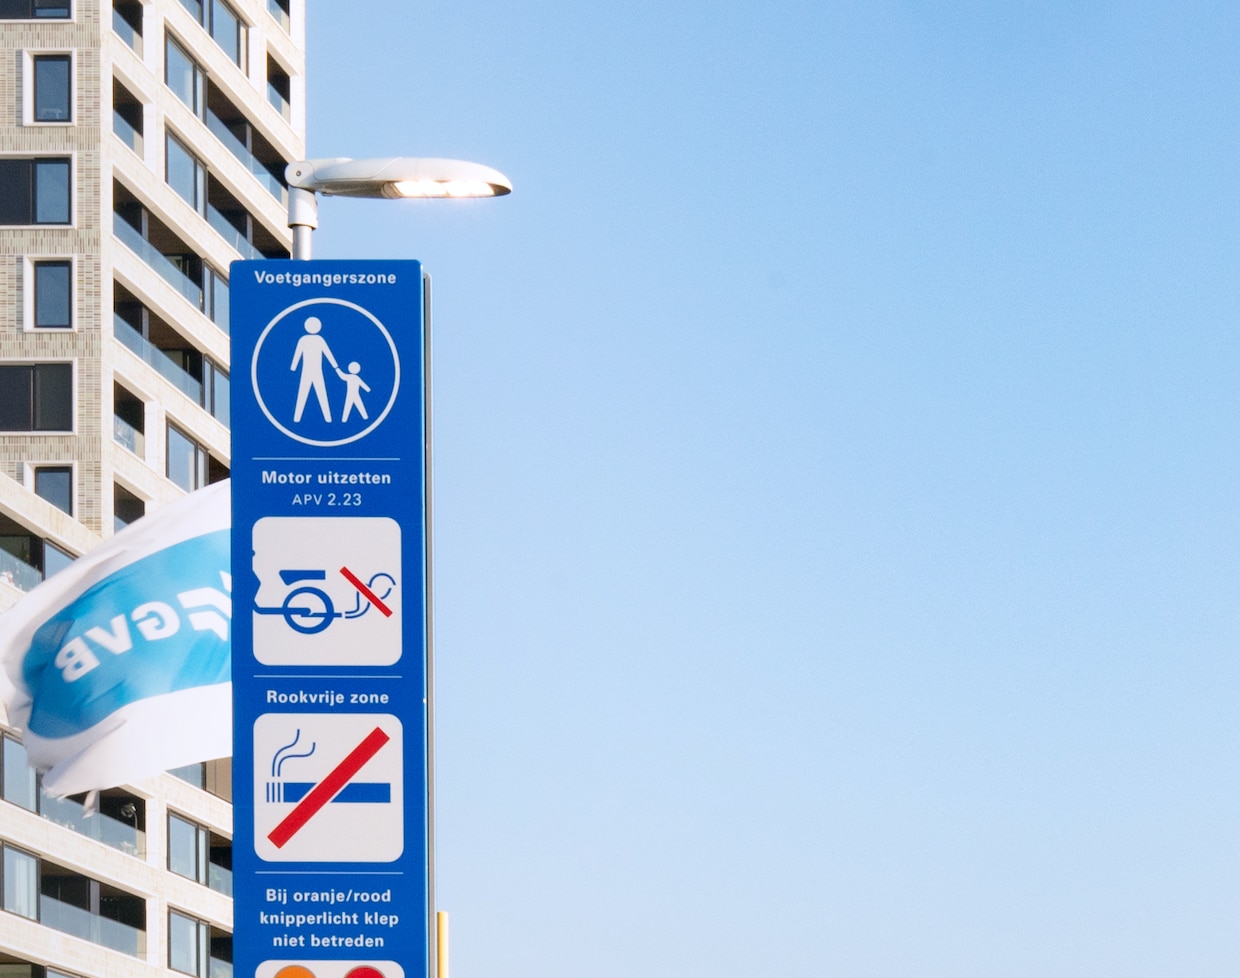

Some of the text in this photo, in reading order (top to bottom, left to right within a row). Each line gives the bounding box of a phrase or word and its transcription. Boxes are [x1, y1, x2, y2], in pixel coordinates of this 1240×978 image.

[254, 270, 397, 287] Voetgangerszone
[261, 470, 391, 485] Motor uitzetten
[292, 492, 362, 506] APV 2.23
[266, 689, 390, 706] Rookvrije zone
[265, 888, 391, 905] Bij oranje/rood
[259, 911, 399, 928] knipperlicht klep
[272, 934, 385, 947] niet betreden
